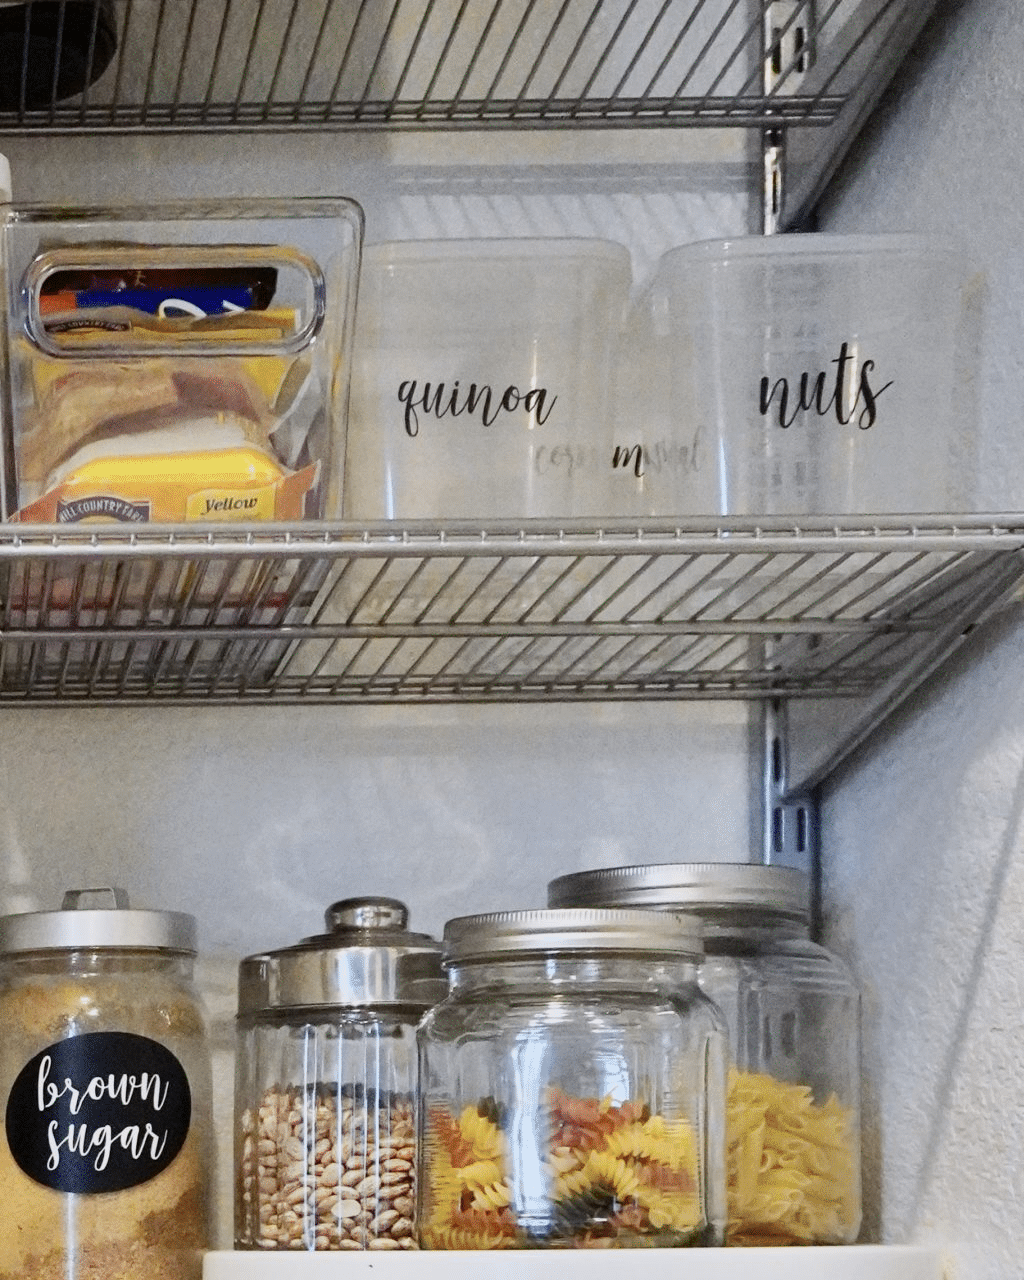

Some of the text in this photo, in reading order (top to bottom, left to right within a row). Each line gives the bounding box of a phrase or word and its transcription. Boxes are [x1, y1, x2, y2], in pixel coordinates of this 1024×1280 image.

[397, 379, 558, 437] quinoa
[759, 342, 894, 431] nuts
[77, 499, 122, 514] COUNTRY
[37, 1055, 169, 1115] brown
[46, 1111, 168, 1172] sugar
